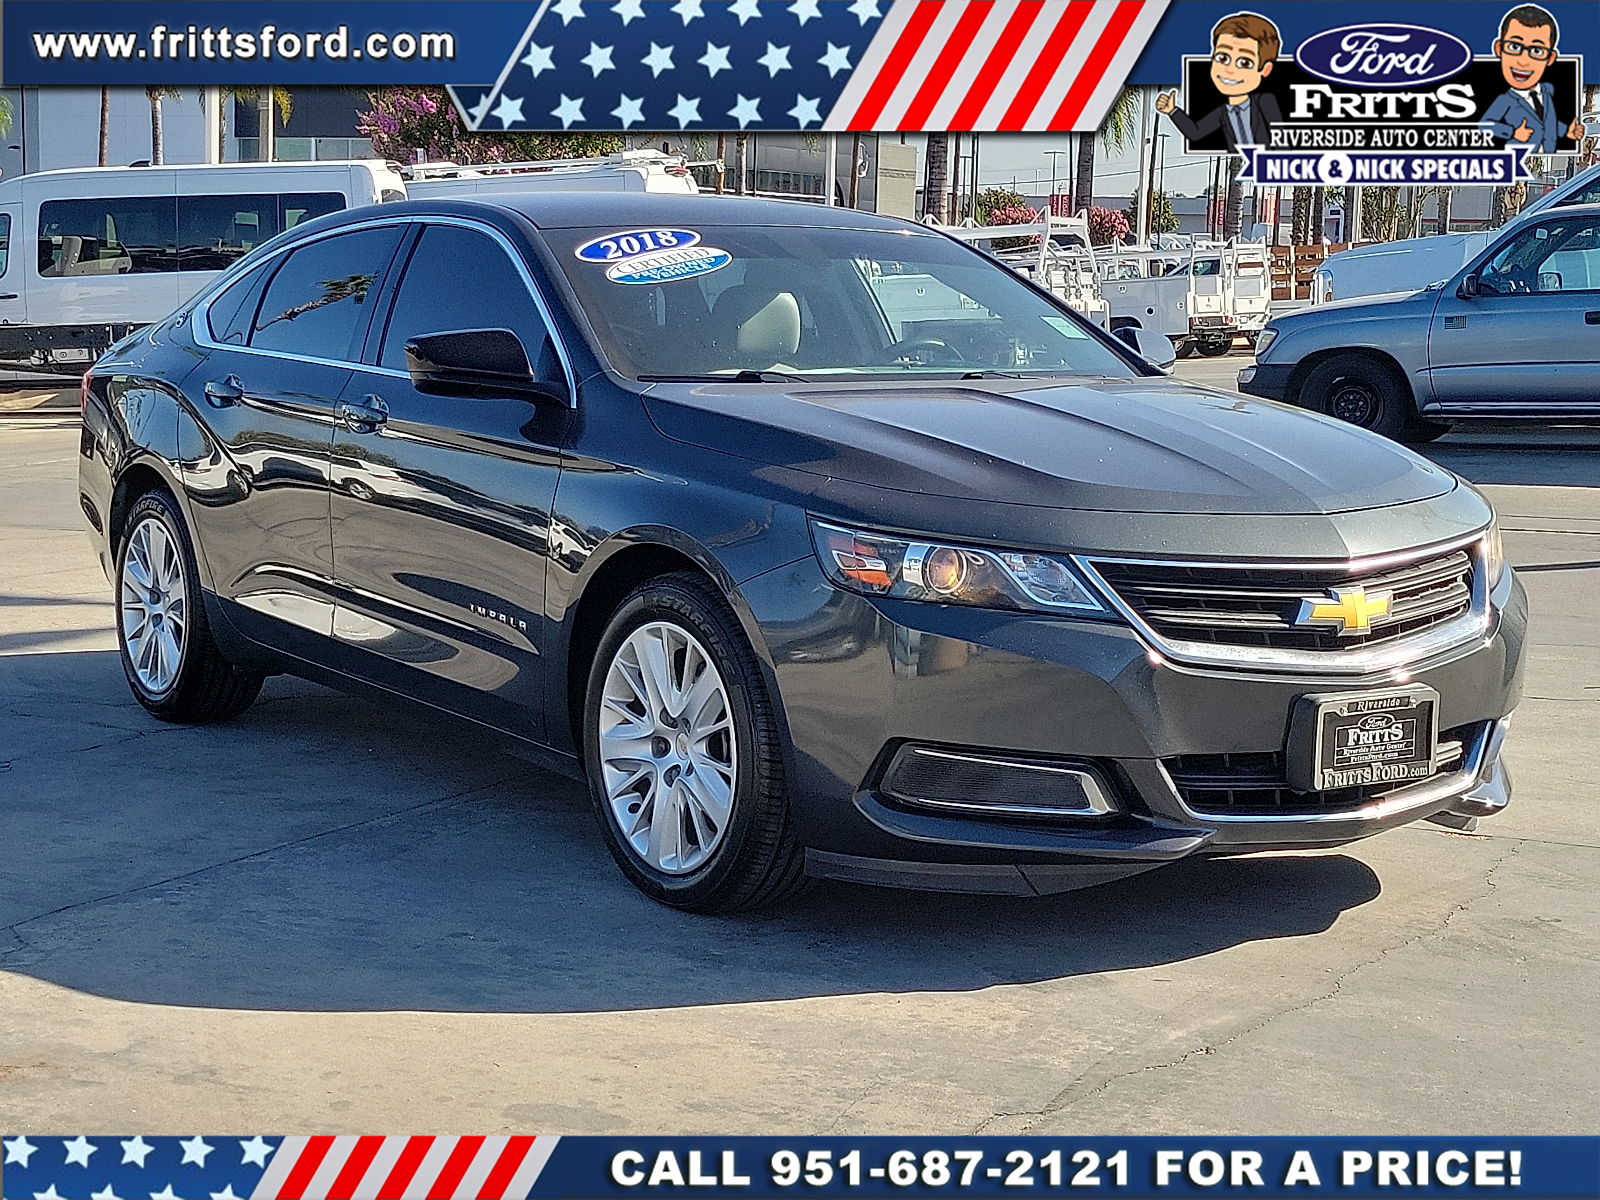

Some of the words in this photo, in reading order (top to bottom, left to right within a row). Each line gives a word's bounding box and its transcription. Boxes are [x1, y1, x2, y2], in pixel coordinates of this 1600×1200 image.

[600, 230, 679, 259] 2018
[616, 248, 710, 274] CERTIFIED
[469, 602, 527, 632] IMPALA
[1357, 697, 1401, 711] Riverside
[1347, 723, 1404, 746] FRITTS
